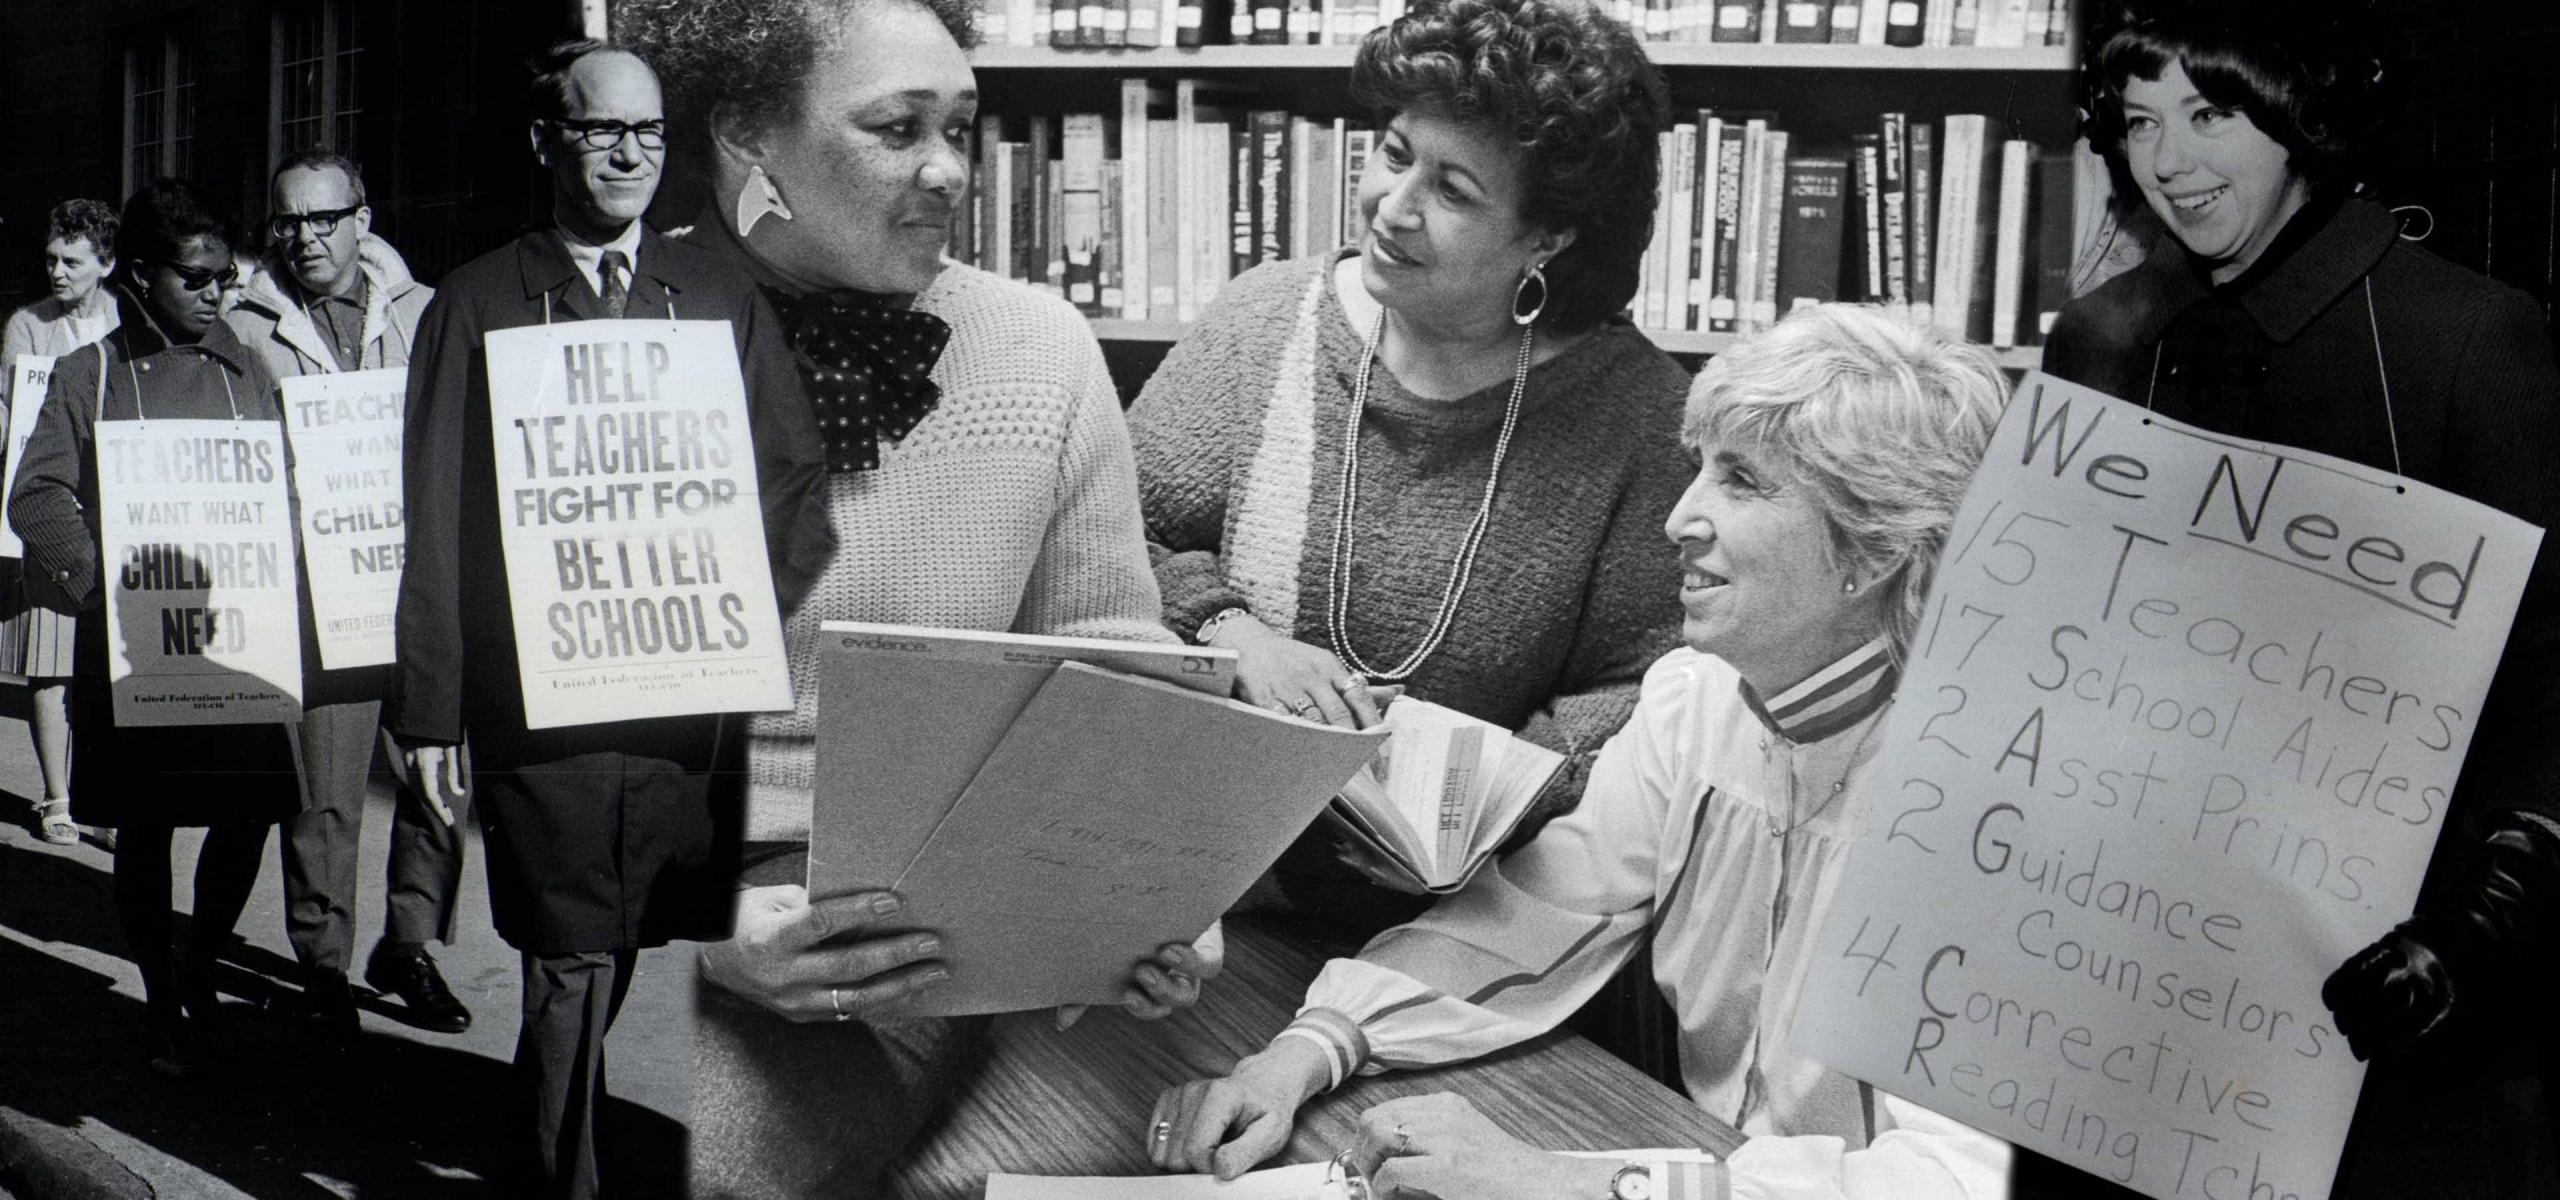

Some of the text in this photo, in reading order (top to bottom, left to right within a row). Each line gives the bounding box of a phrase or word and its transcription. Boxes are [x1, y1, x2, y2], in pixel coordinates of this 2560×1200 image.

[27, 369, 46, 384] PR
[563, 341, 670, 405] HELP
[108, 437, 274, 484] TEACHERS
[514, 408, 733, 480] TEACHERS
[126, 501, 264, 526] WANT WHAT
[325, 468, 391, 493] WHAT
[514, 478, 738, 527] FIGHT FOR
[2020, 383, 2487, 624] We Need
[120, 542, 279, 590] CHILDREN
[553, 527, 722, 591] BETTER
[162, 607, 247, 656] NEED
[547, 592, 750, 661] SCHOOLS
[1953, 500, 2463, 752] 15 Teachers
[134, 692, 281, 703] United Federation of Teachers
[1919, 685, 1970, 760] 2
[1925, 592, 2450, 826] 17 School Aides
[1886, 778, 2243, 952] 2 Guidance
[2015, 908, 2329, 1059] Counselors
[1842, 916, 2274, 1132] 4 Corrective
[1904, 1017, 2139, 1184] Reading
